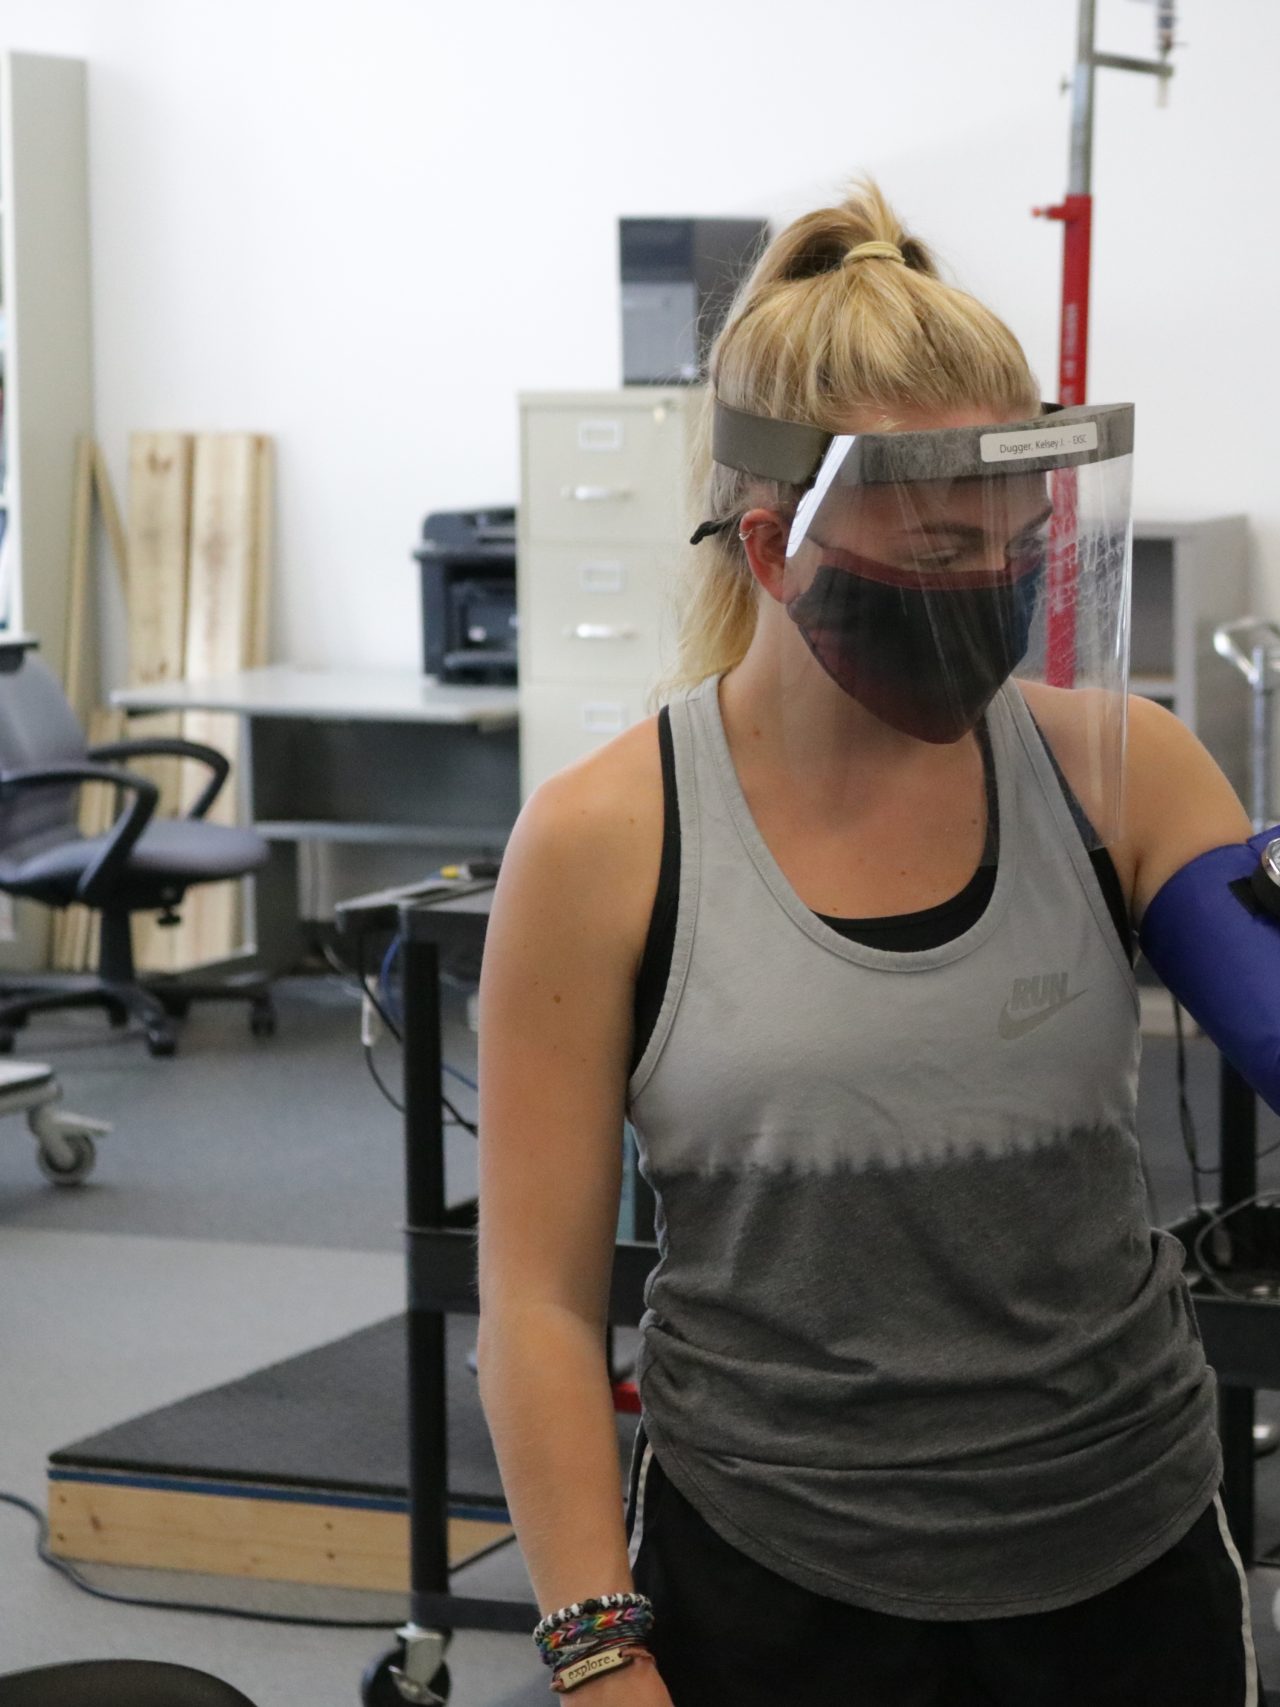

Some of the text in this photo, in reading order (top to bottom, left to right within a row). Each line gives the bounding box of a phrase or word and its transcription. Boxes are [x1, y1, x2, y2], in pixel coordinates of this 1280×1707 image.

[999, 443, 1034, 455] Dugger,
[1035, 438, 1059, 449] Kelsey
[567, 1656, 615, 1681] explore.
